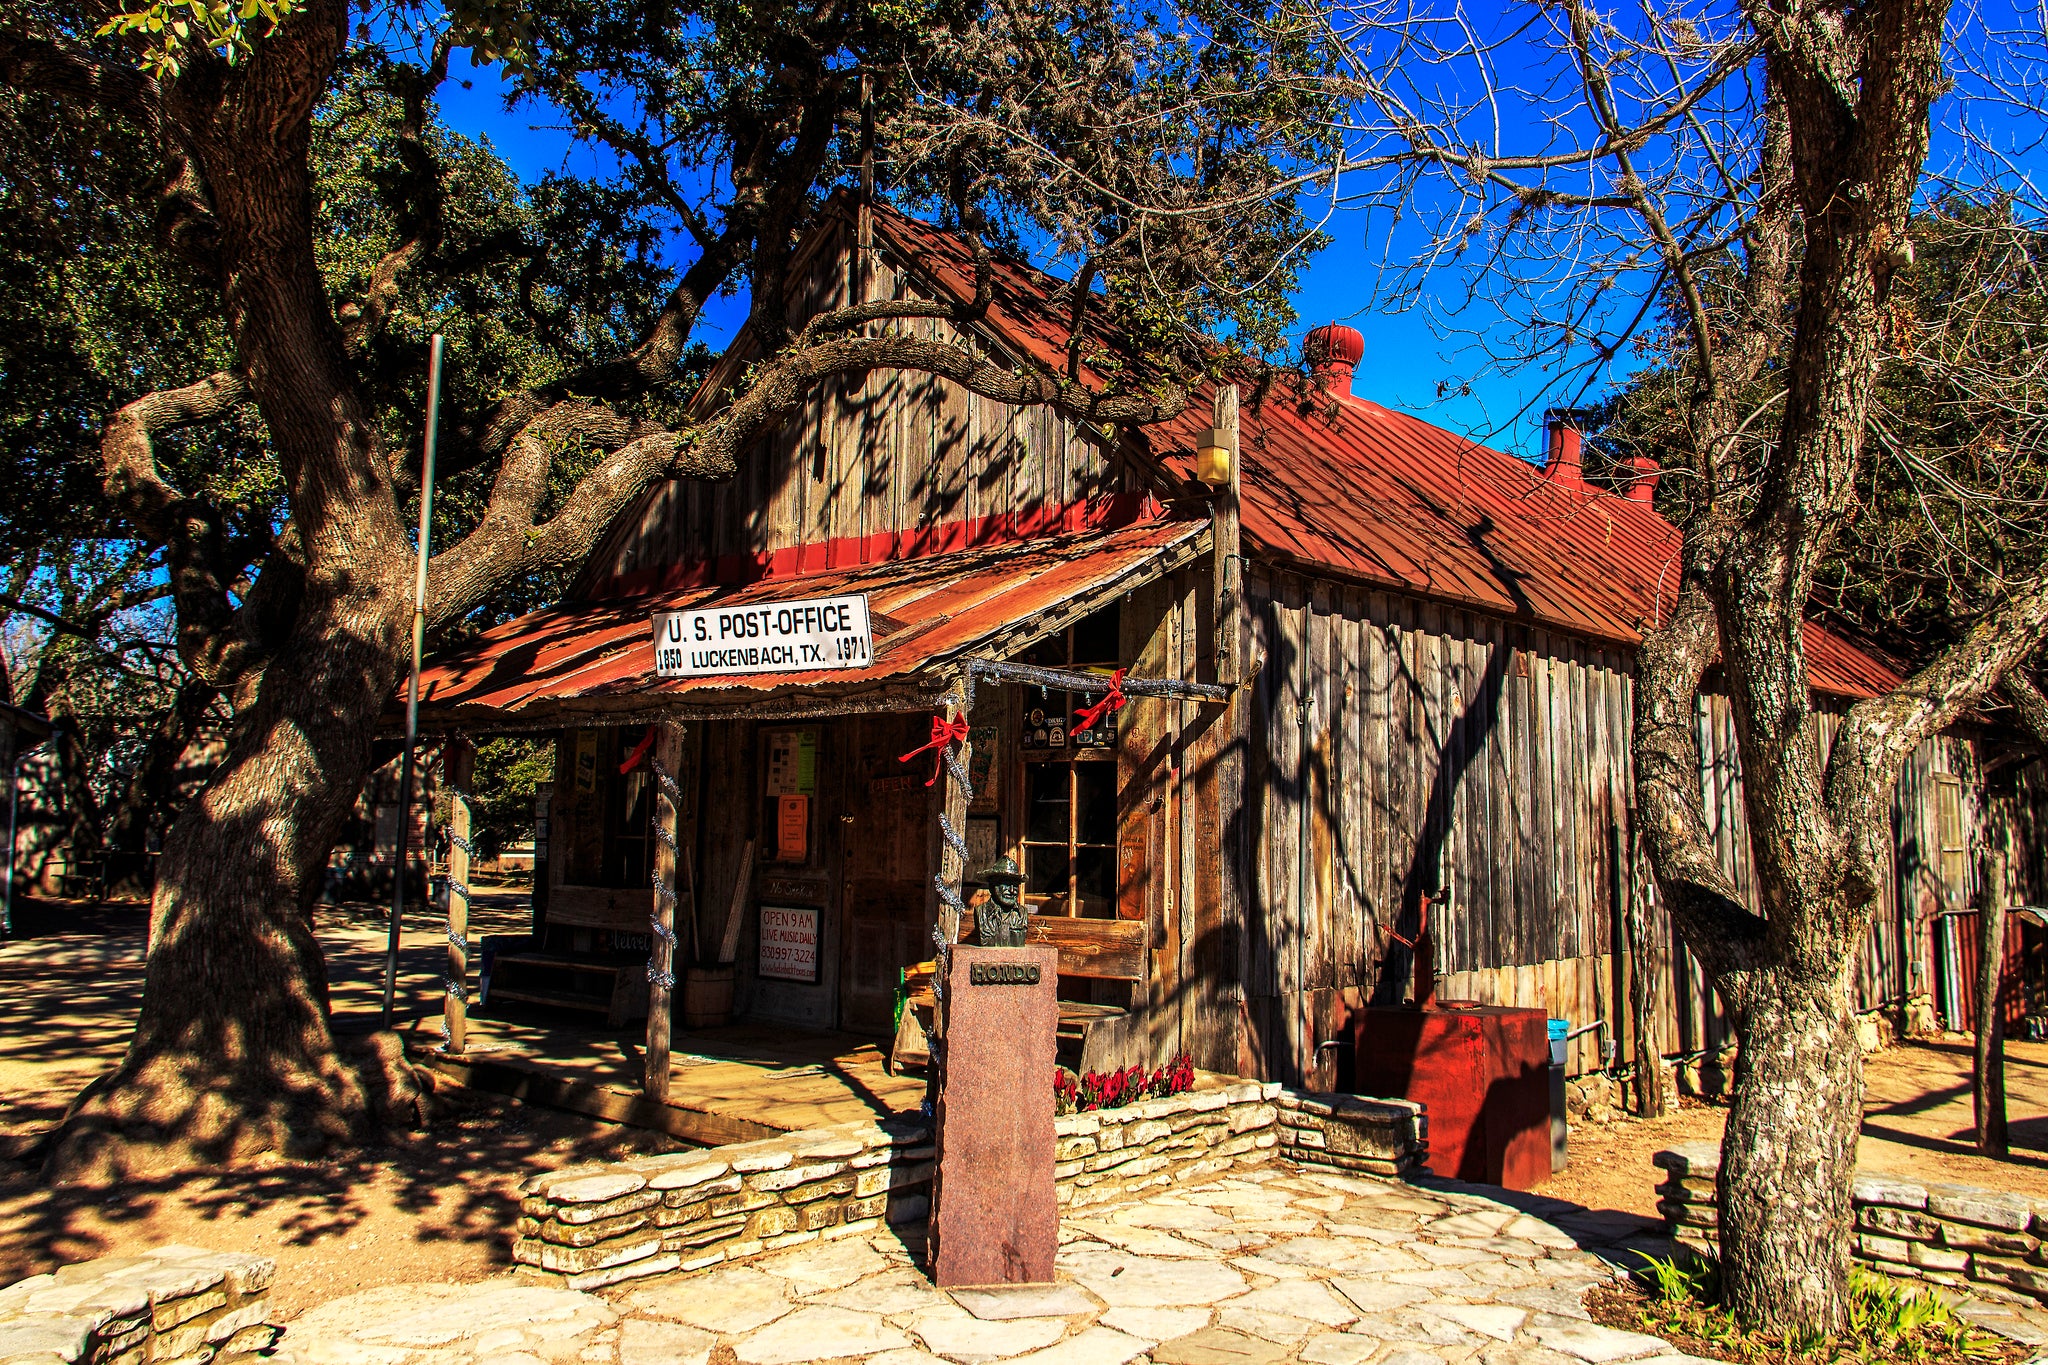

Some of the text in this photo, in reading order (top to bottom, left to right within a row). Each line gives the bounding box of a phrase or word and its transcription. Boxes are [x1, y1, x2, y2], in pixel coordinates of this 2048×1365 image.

[668, 604, 852, 643] U. S. POST-OFFICE
[657, 648, 683, 670] 1850
[836, 636, 867, 660] 1971
[763, 911, 813, 929] OPEN 9 AM
[761, 928, 817, 945] LIVE MUSIC DAILY
[972, 963, 1039, 981] HONDO
